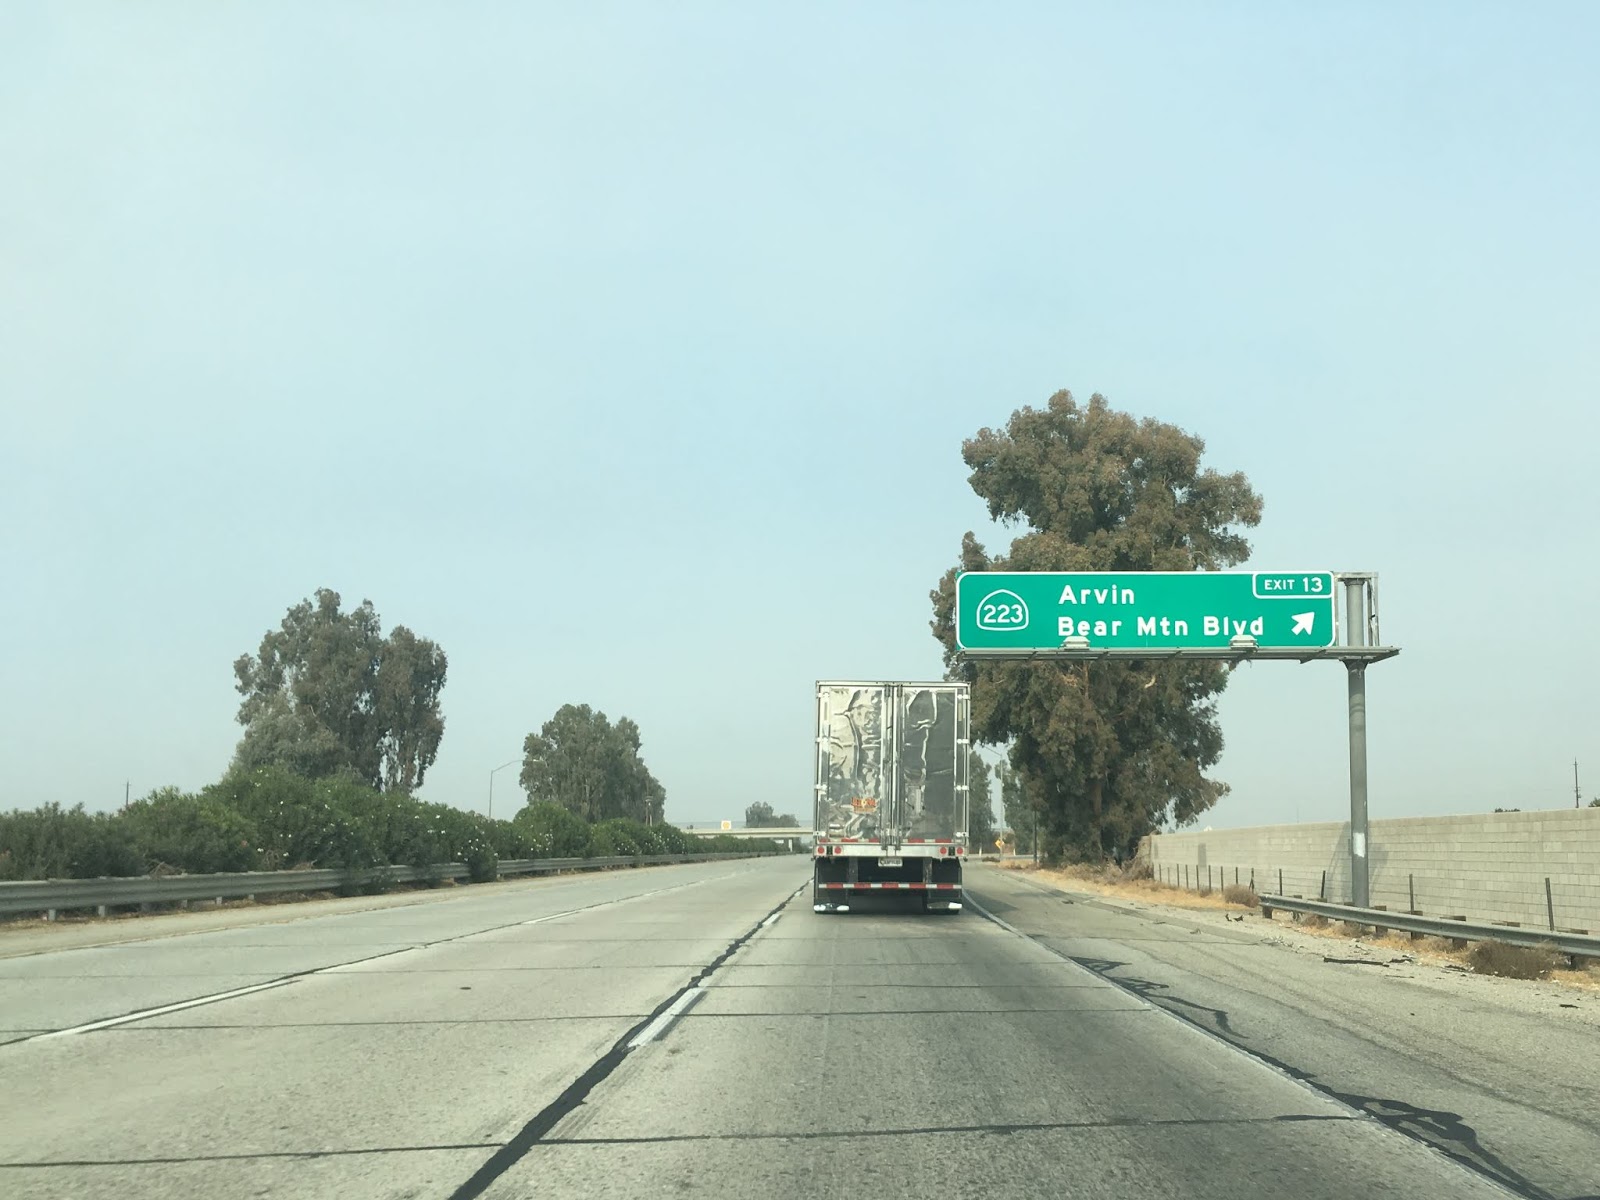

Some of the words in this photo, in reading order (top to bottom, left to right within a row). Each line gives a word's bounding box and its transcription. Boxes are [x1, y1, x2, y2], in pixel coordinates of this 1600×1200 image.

[1058, 584, 1135, 605] Arvin
[1264, 579, 1296, 591] EXIT
[1302, 576, 1323, 593] 13
[983, 604, 1024, 624] 223
[1058, 616, 1122, 636] Bear
[1137, 616, 1188, 636] Mtn
[1203, 615, 1264, 636] Blvd
